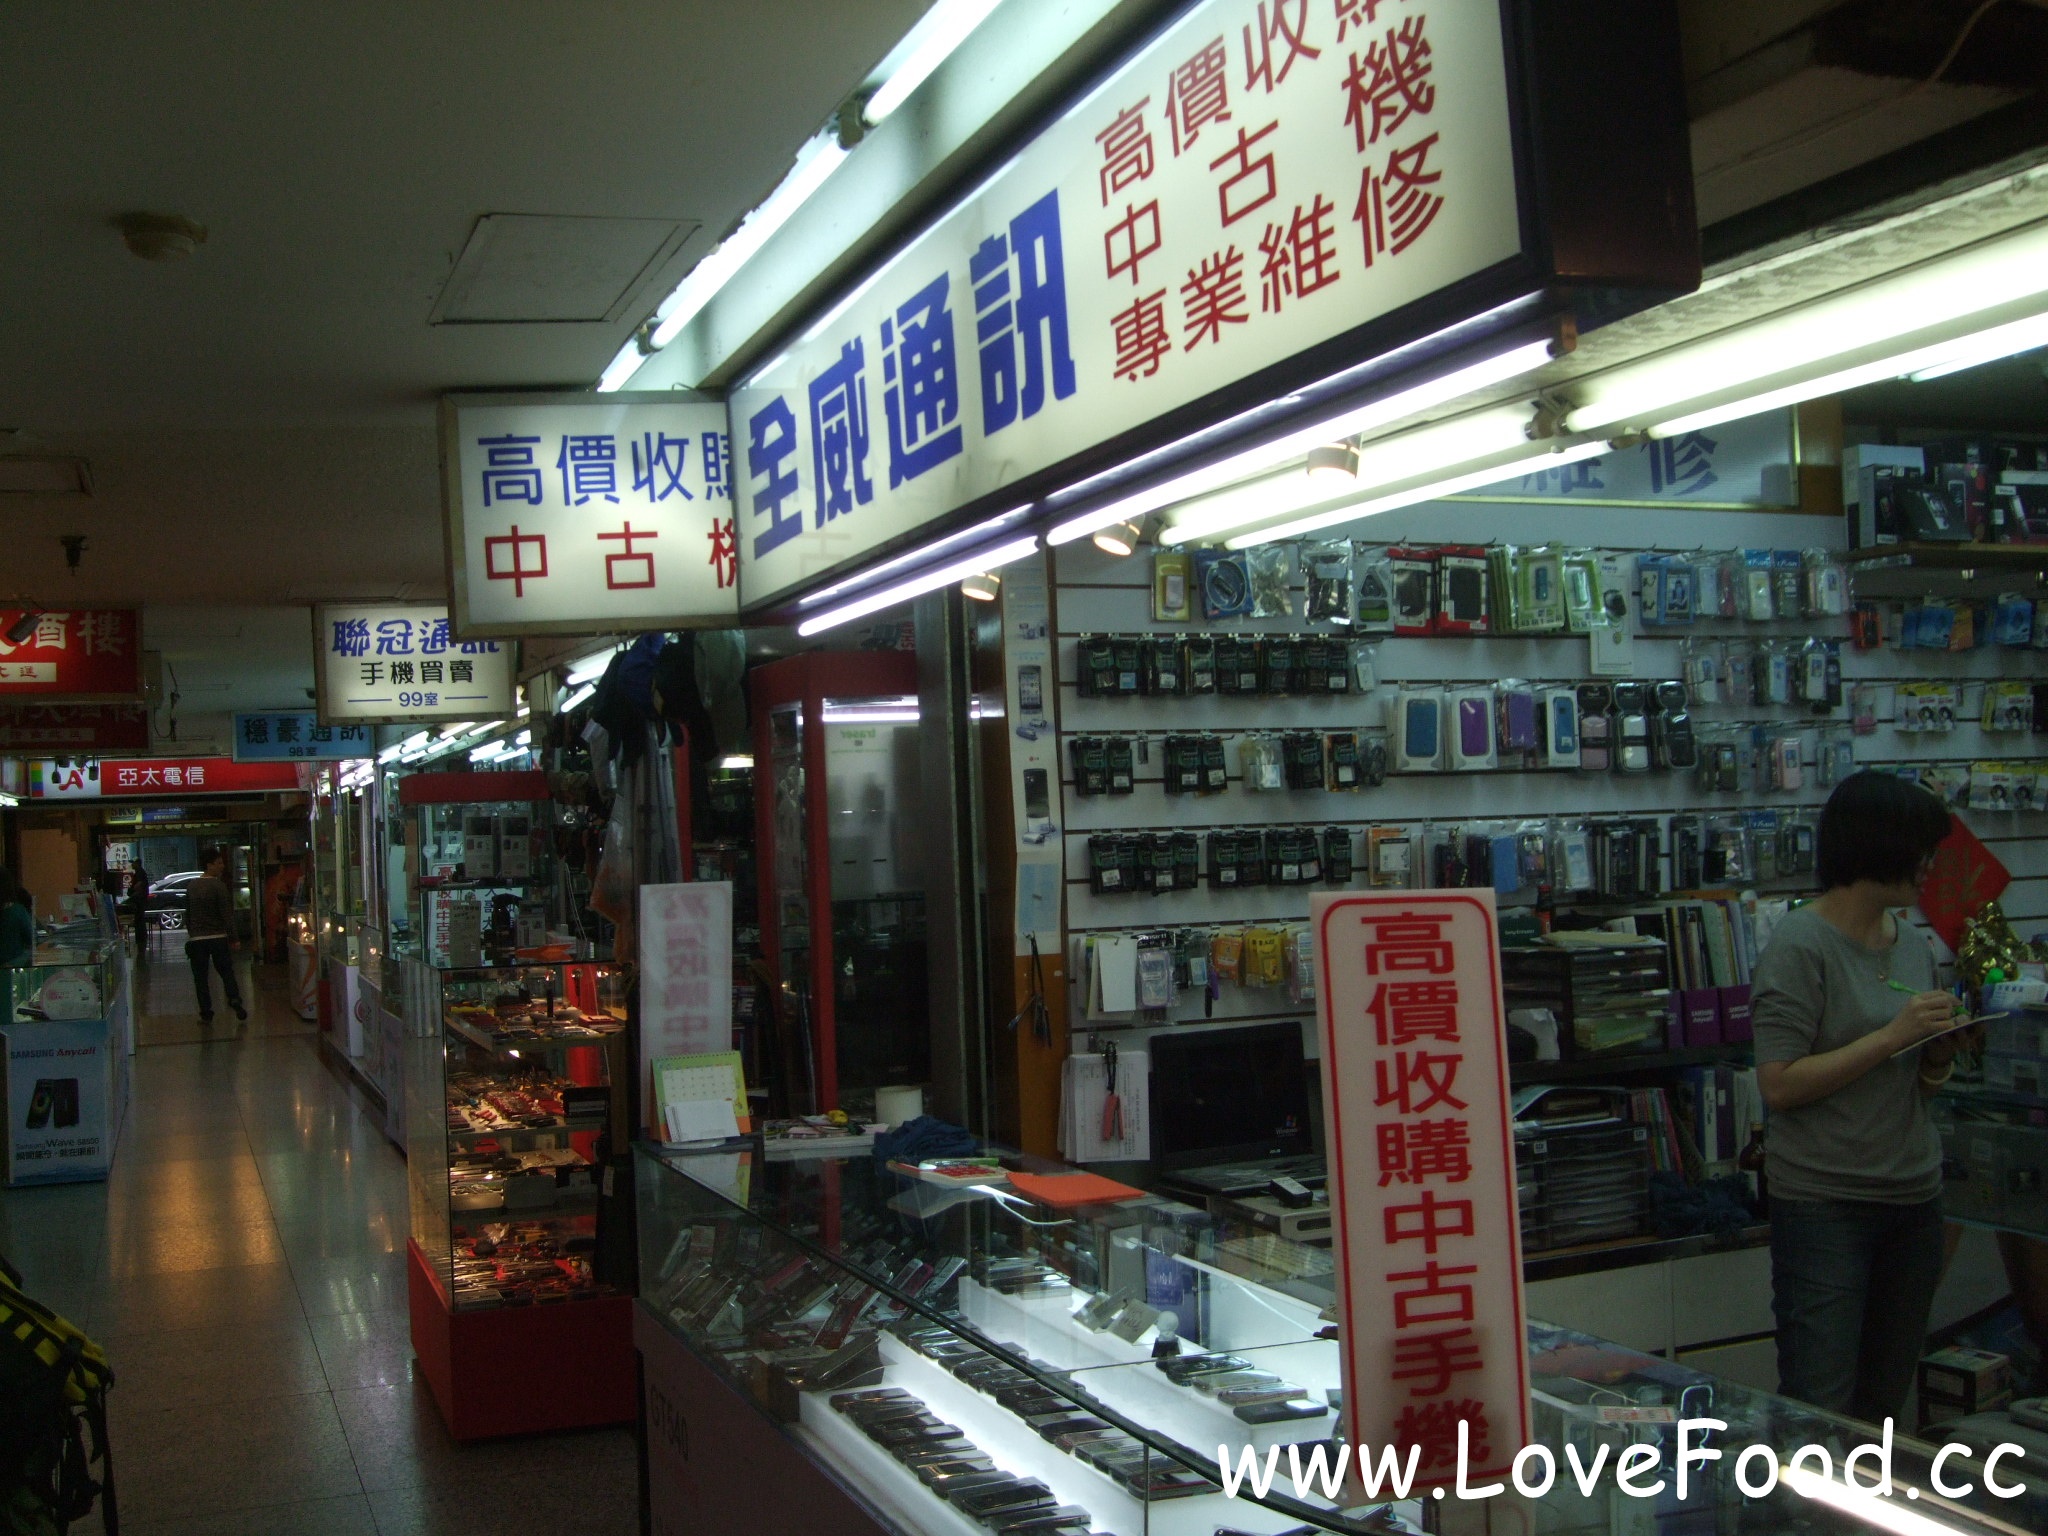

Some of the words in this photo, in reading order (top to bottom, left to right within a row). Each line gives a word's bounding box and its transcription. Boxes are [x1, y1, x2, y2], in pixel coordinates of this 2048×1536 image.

[1095, 0, 1383, 207] 高價收
[1104, 14, 1435, 285] 中古機
[1110, 131, 1444, 384] 專業維修
[747, 187, 1078, 561] 全威通訊
[118, 765, 206, 787] 亞太電信
[360, 659, 473, 686] 手機買賣
[398, 690, 439, 707] 99室
[11, 1049, 54, 1059] SAMSUNG
[57, 1046, 97, 1057] Anycall
[1360, 911, 1490, 1471] 高價收購中古手機
